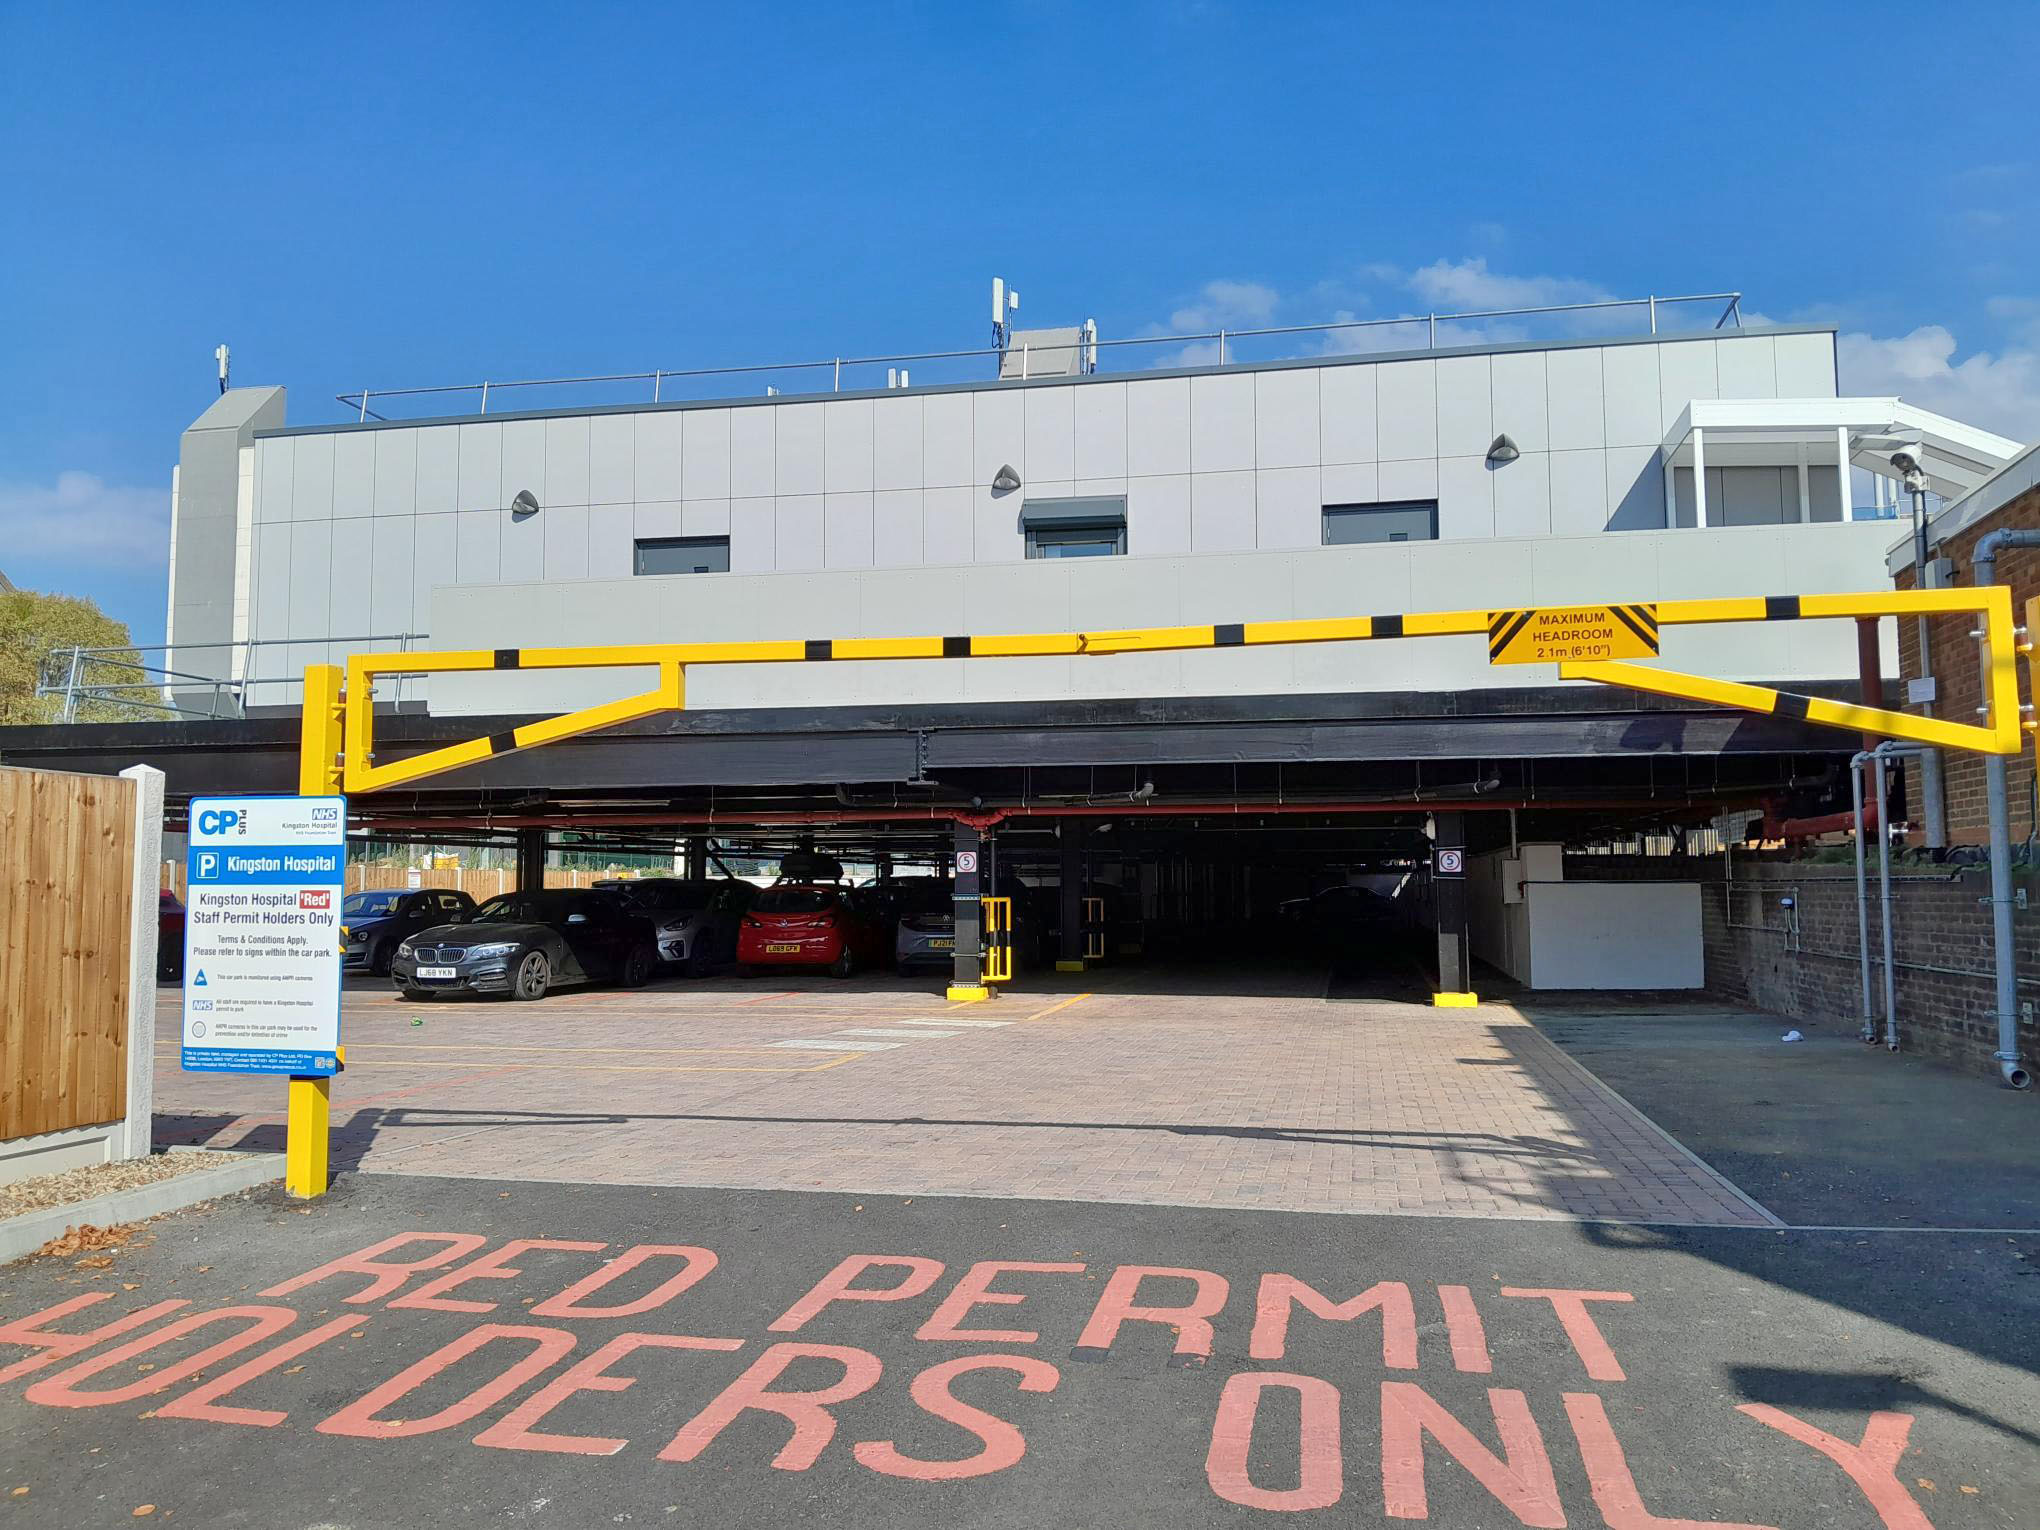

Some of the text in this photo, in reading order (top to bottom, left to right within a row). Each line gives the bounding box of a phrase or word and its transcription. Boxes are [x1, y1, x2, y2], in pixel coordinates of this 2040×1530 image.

[1539, 612, 1606, 626] MAXIMUM
[1533, 628, 1613, 642] HEADROOM
[1537, 648, 1567, 658] 2.1m
[312, 808, 337, 820] NHS
[198, 810, 247, 835] CP PLUS
[200, 855, 216, 877] P
[228, 856, 336, 874] Kingston Hospital
[964, 856, 970, 866] 5
[1446, 854, 1454, 866] 5
[200, 892, 330, 908] Kingston Hospital 'Red'
[194, 912, 334, 927] Staff Permit Holders Only
[218, 934, 308, 946] Terms & Conditions Apply.
[193, 947, 216, 956] Please
[218, 948, 234, 956] refer
[236, 948, 242, 956] to
[245, 948, 263, 958] signs
[265, 948, 286, 957] within
[288, 948, 300, 957] the
[314, 949, 332, 958] park.
[438, 968, 453, 976] YKN
[192, 1000, 213, 1010] NHS
[257, 1231, 1635, 1381] RED PERMIT
[0, 1291, 1933, 1530] HOLDERS ONLY
